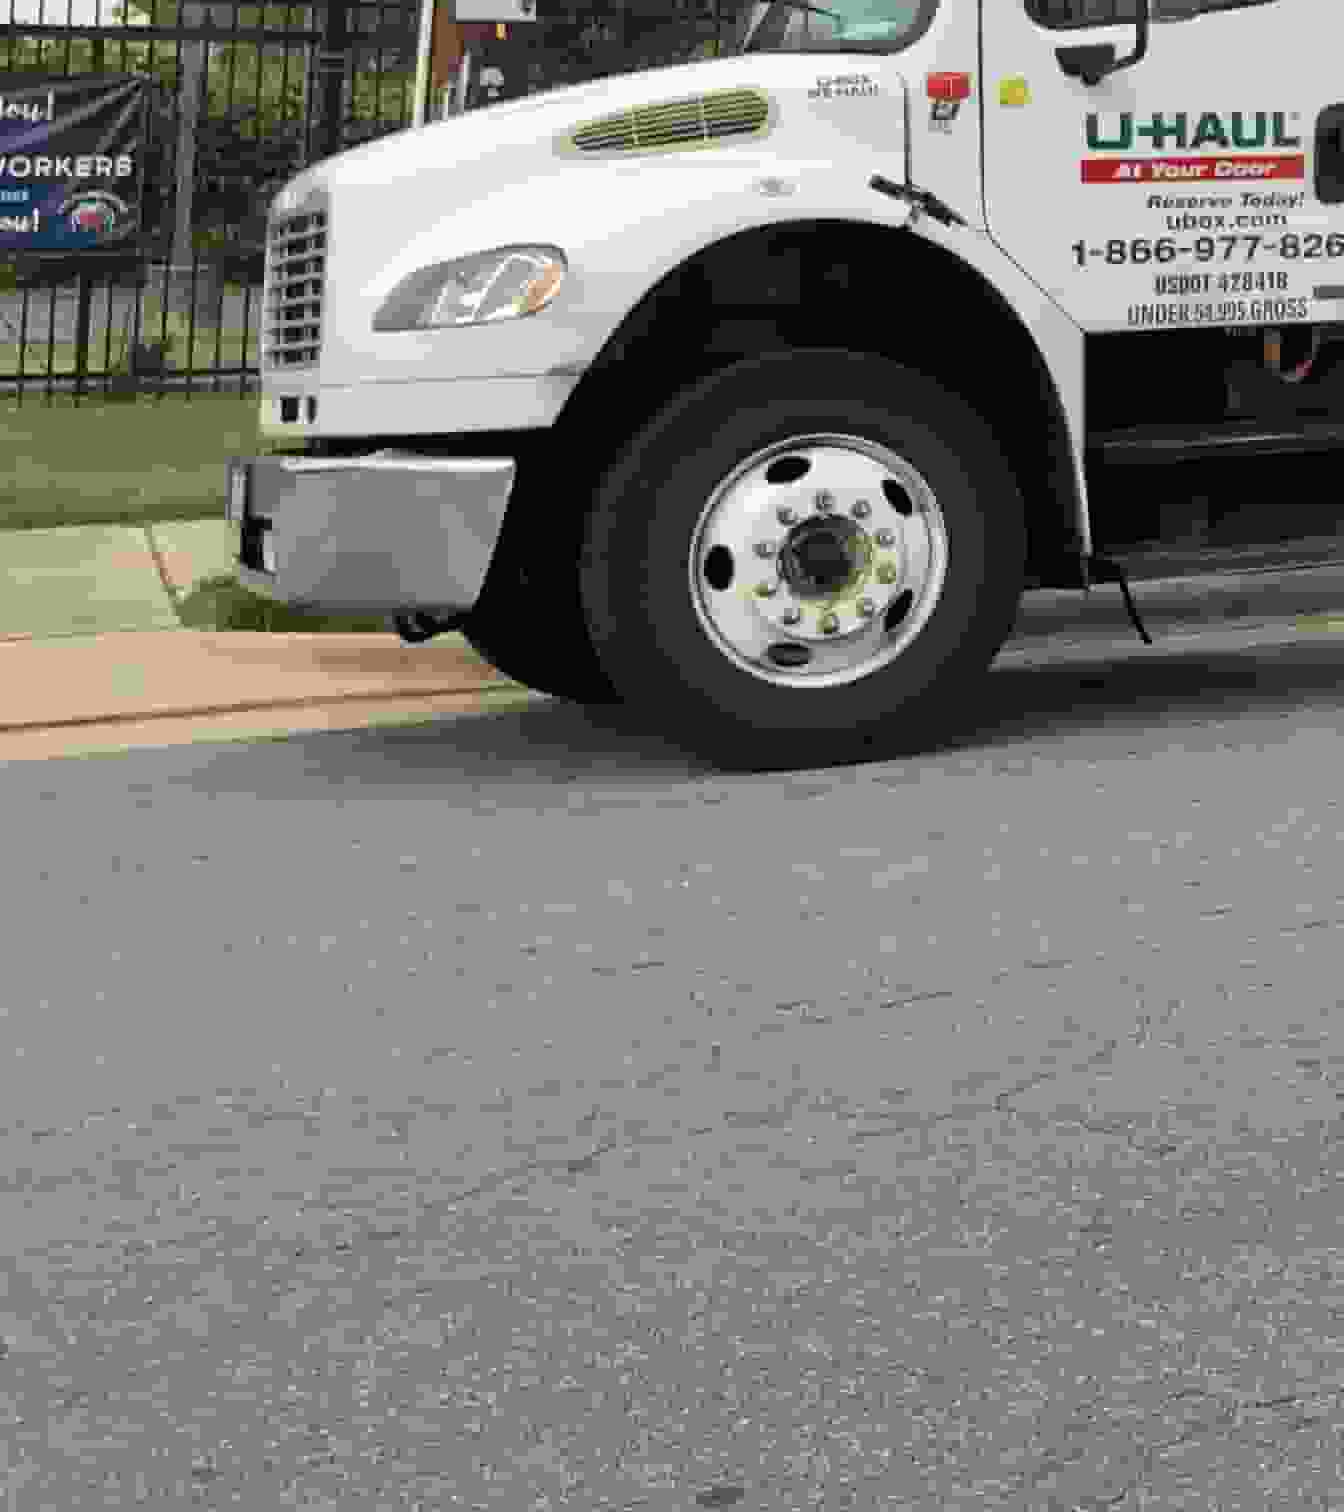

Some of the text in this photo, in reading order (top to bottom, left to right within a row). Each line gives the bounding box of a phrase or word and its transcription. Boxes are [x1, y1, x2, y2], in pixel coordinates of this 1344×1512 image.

[1086, 112, 1301, 150] U-HAUL
[1113, 160, 1277, 178] At Your Door
[1147, 191, 1305, 209] Reserve Today!
[1166, 212, 1288, 231] ubox.com
[1153, 274, 1211, 295] USDOT
[1127, 303, 1189, 326] UNDER
[1250, 297, 1310, 321] GROSS
